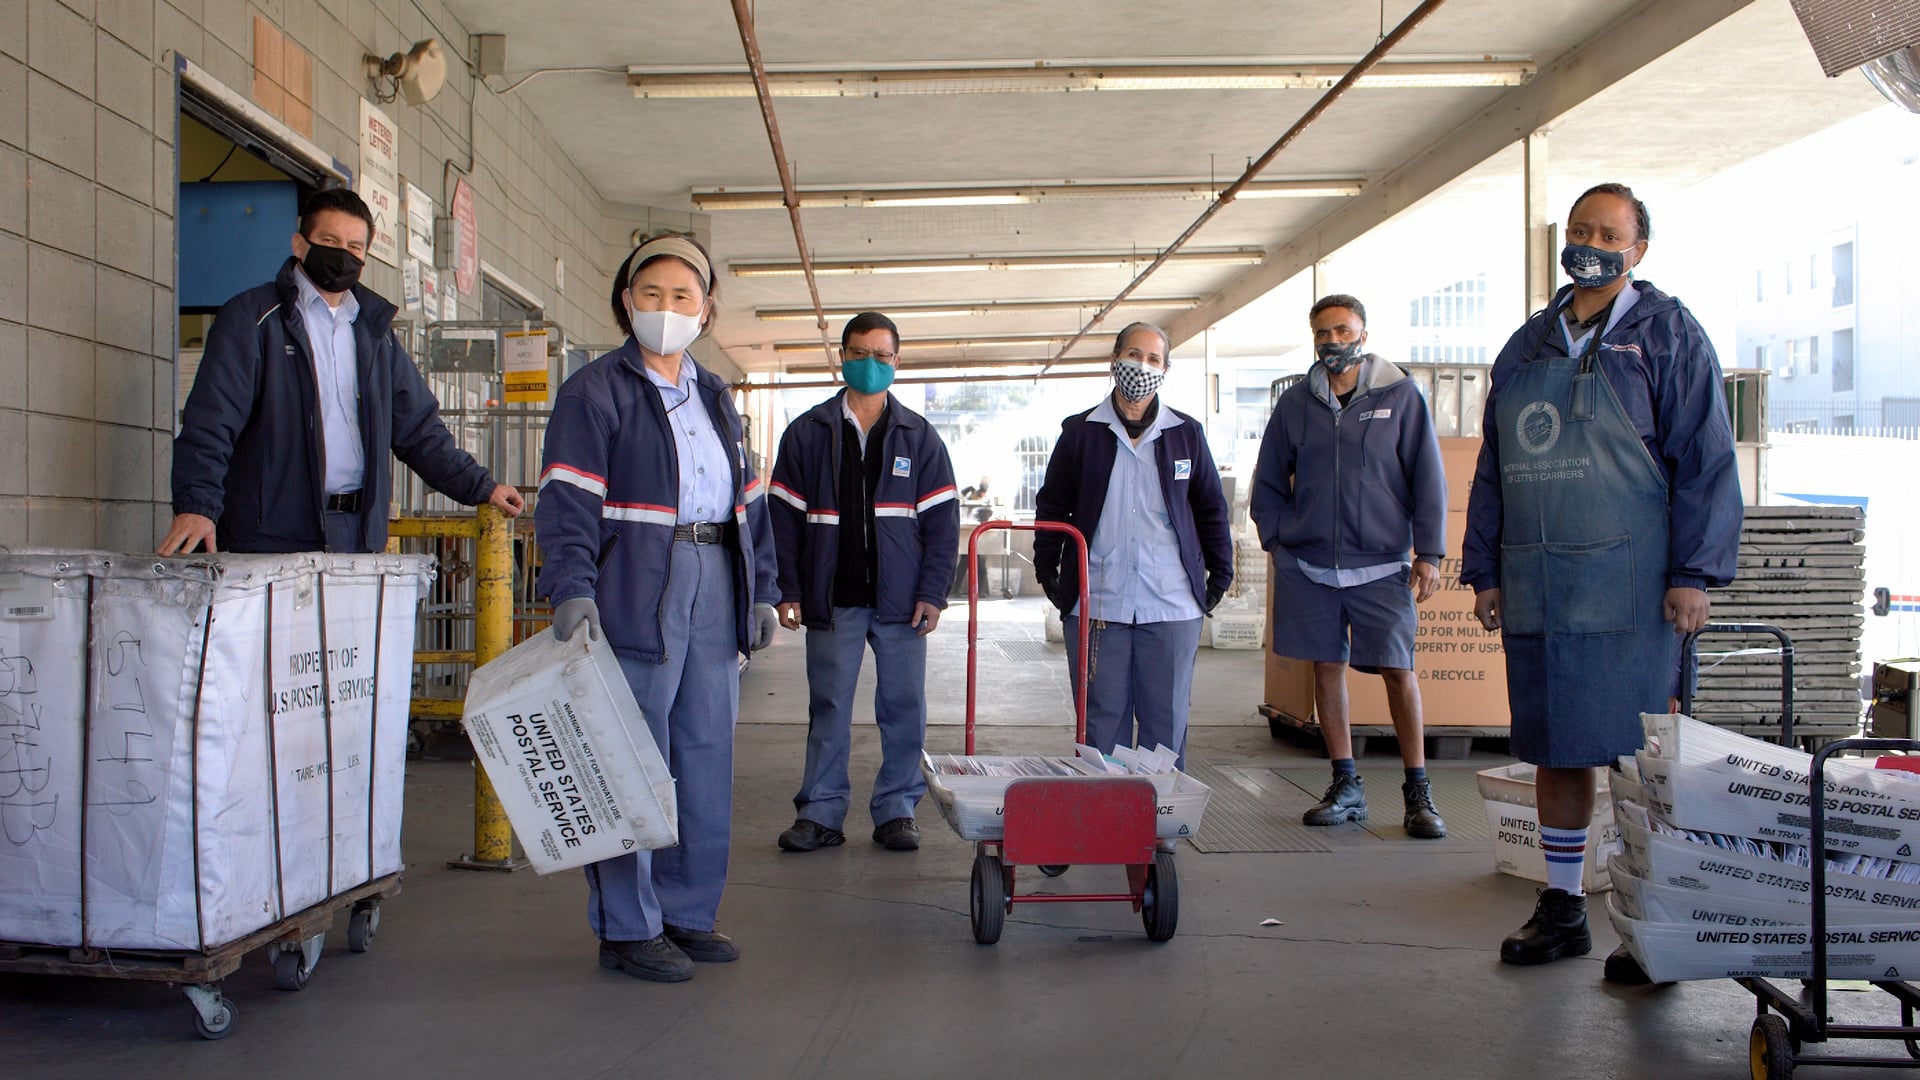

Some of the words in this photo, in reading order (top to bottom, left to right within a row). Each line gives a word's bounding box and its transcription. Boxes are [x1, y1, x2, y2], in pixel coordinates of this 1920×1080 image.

[368, 115, 393, 145] METERED
[370, 132, 391, 160] LETTERS
[373, 190, 388, 210] FLATS
[1532, 457, 1590, 469] ASSOCIATION
[1515, 473, 1538, 482] LETTER
[1540, 470, 1584, 480] CARRIERS
[1420, 611, 1436, 621] DO
[1440, 611, 1462, 621] NOT
[1431, 627, 1453, 636] FOR
[1457, 628, 1499, 637] MULTIP
[342, 647, 357, 667] OF
[1414, 642, 1457, 652] OPERTY
[1461, 643, 1475, 652] OF
[1432, 670, 1485, 680] RECYCLE
[291, 685, 335, 711] POST
[338, 677, 374, 701] SERVICE
[564, 703, 584, 737] WARNING
[582, 743, 593, 759] NOT
[590, 760, 600, 775] FOR
[598, 776, 616, 808] PRIVATE
[611, 806, 622, 821] USE
[506, 714, 546, 778] POSTAL
[538, 781, 581, 849] SERVICE
[529, 713, 566, 771] UNITED
[558, 774, 596, 836] STATES
[1727, 754, 1780, 776] UNITED
[1783, 770, 1837, 793] STAES
[517, 763, 527, 777] FOR
[523, 776, 533, 793] MAIL
[530, 792, 543, 809] ONLY
[1728, 782, 1782, 801] UNITED
[1784, 793, 1839, 811] STAES
[1840, 801, 1895, 817] POSTAL
[1501, 816, 1535, 832] UNITED
[1498, 831, 1536, 848] POSTAL
[1758, 827, 1776, 837] MM
[1778, 831, 1804, 840] TRAY
[1824, 837, 1839, 846] RS
[1841, 840, 1860, 849] 74P
[1699, 860, 1753, 881] UNITED
[1756, 872, 1811, 893] STATES
[1825, 885, 1868, 902] OSTAL
[1871, 892, 1920, 909] SERVIC
[1692, 909, 1747, 926] UNITED
[1696, 931, 1750, 944] UNITED
[1752, 932, 1807, 945] STATES
[1869, 930, 1920, 943] SERVIC
